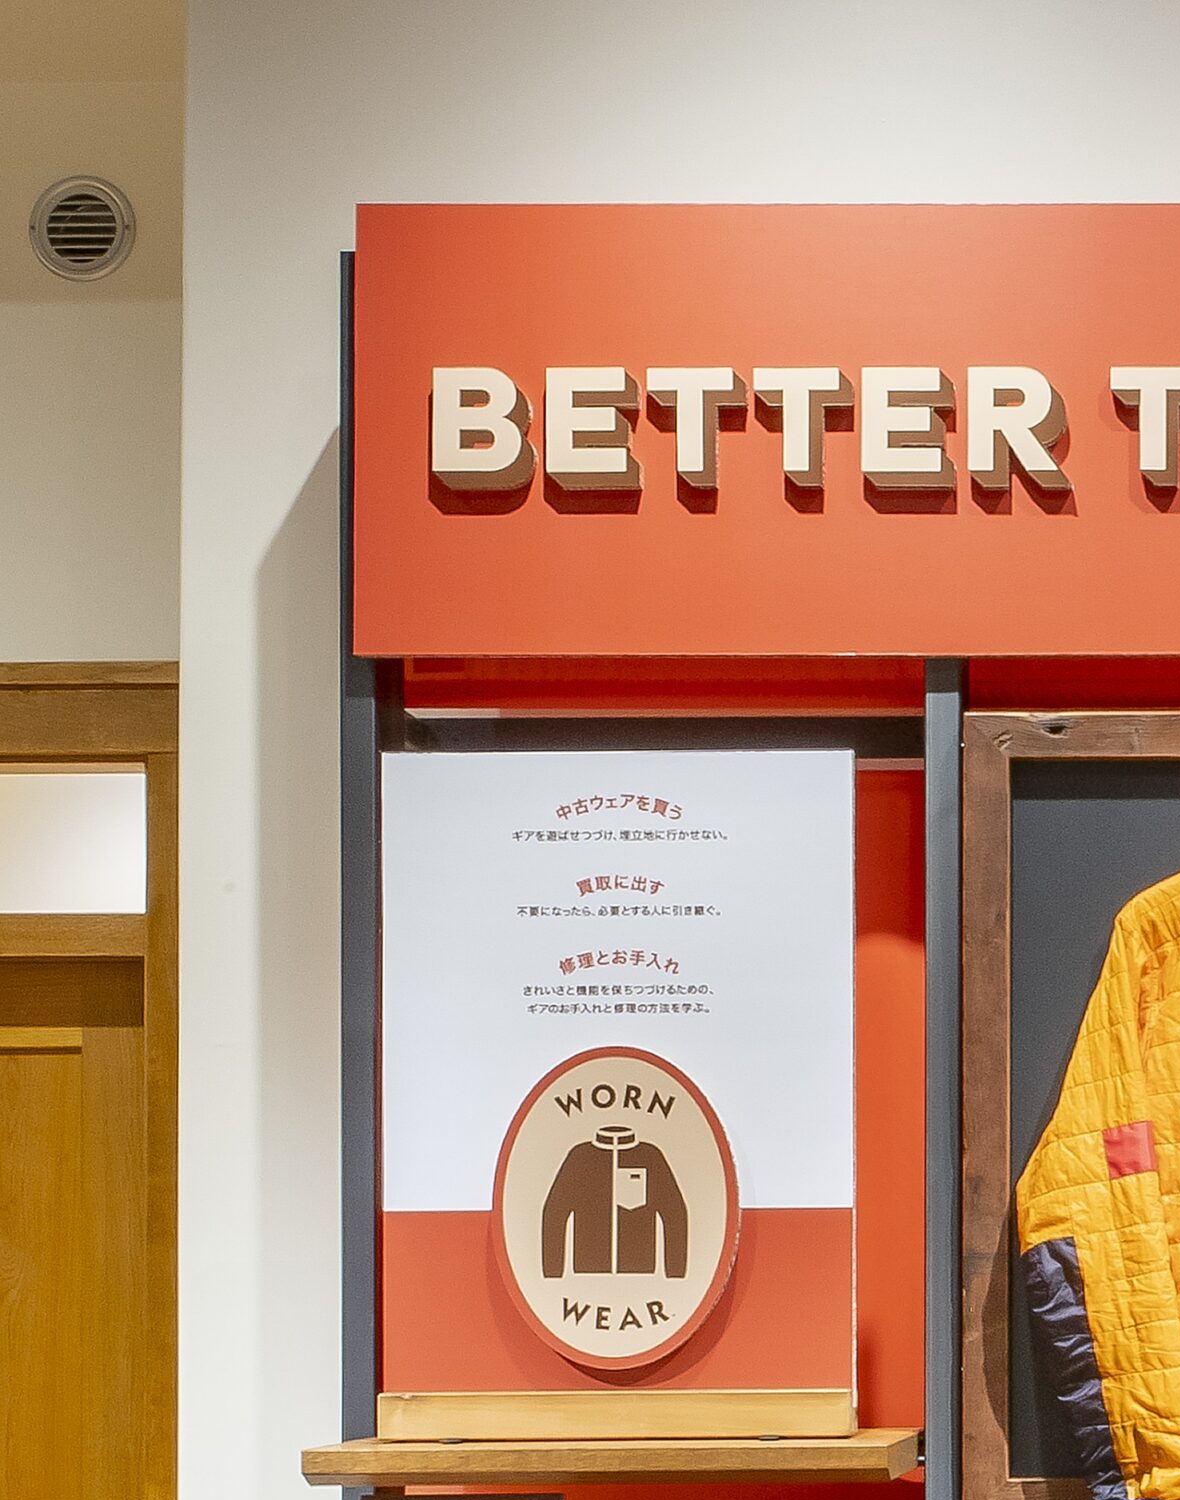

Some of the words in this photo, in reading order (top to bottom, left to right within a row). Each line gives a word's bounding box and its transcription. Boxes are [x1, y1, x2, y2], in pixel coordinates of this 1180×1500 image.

[430, 366, 1073, 490] BETTER
[555, 793, 684, 821] 中古ウェアを買う
[575, 874, 665, 897] 買取に出す
[558, 949, 681, 976] 修理とお手入れ
[554, 1084, 676, 1119] WORN
[562, 1298, 670, 1331] WEAR
